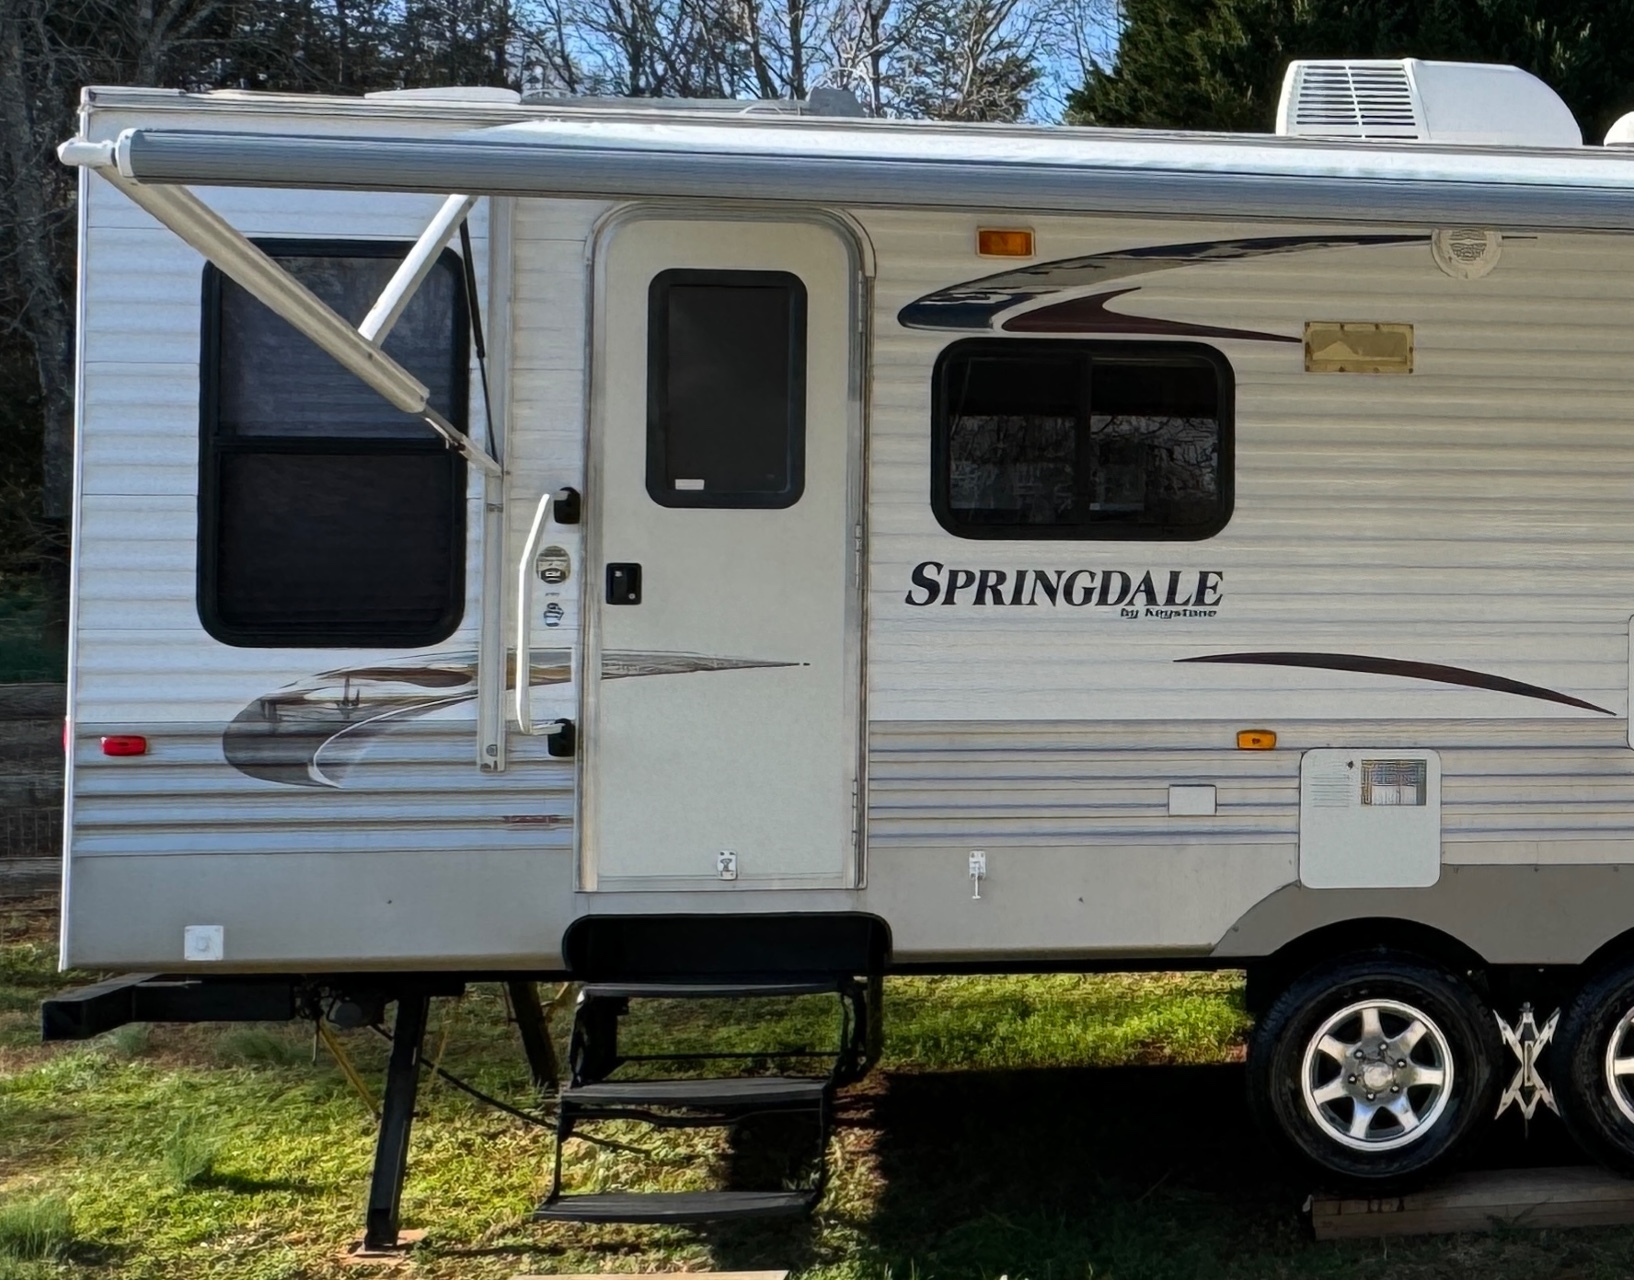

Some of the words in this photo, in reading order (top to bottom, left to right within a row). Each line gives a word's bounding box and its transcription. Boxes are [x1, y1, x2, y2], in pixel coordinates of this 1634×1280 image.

[905, 561, 1224, 606] SPRINGDALE
[1120, 607, 1139, 620] by
[1144, 607, 1217, 620] Keystone
